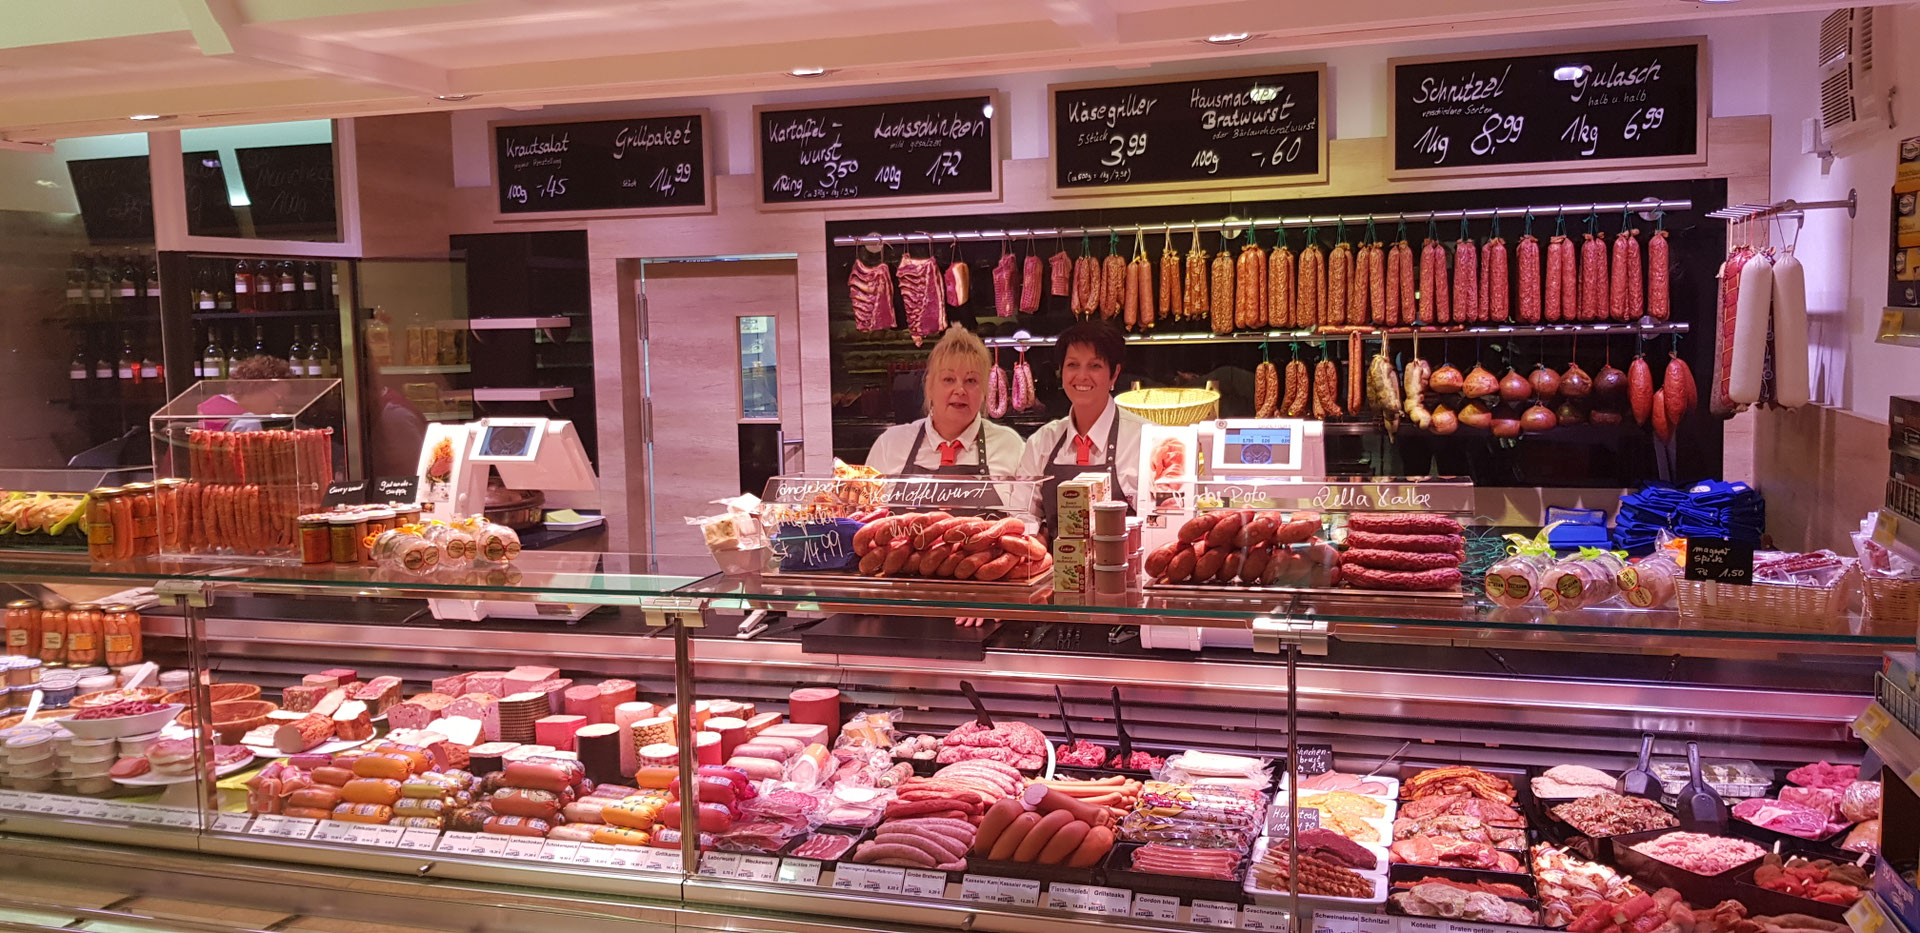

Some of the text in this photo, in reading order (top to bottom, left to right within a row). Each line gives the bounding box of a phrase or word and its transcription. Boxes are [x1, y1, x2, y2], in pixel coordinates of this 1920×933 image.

[1412, 64, 1511, 104] Schnitzel
[1571, 59, 1661, 102] Gulasch
[874, 112, 984, 139] Lachsschinken
[1068, 93, 1157, 128] Käsegriller
[1202, 94, 1295, 130] Bratwurst
[1623, 107, 1665, 141] 6,99
[506, 132, 570, 158] Krautsalat
[613, 120, 691, 159] Grillpaket
[800, 133, 842, 166] wurst
[1101, 133, 1148, 167] 3,99
[1470, 113, 1524, 156] 8,99
[1561, 115, 1599, 156] 1kg
[819, 159, 859, 189] 3,50
[875, 166, 901, 189] 100g
[926, 151, 962, 185] 1,72
[1192, 150, 1220, 173] 100g
[507, 184, 528, 203] 100g
[650, 163, 691, 197] 14,99
